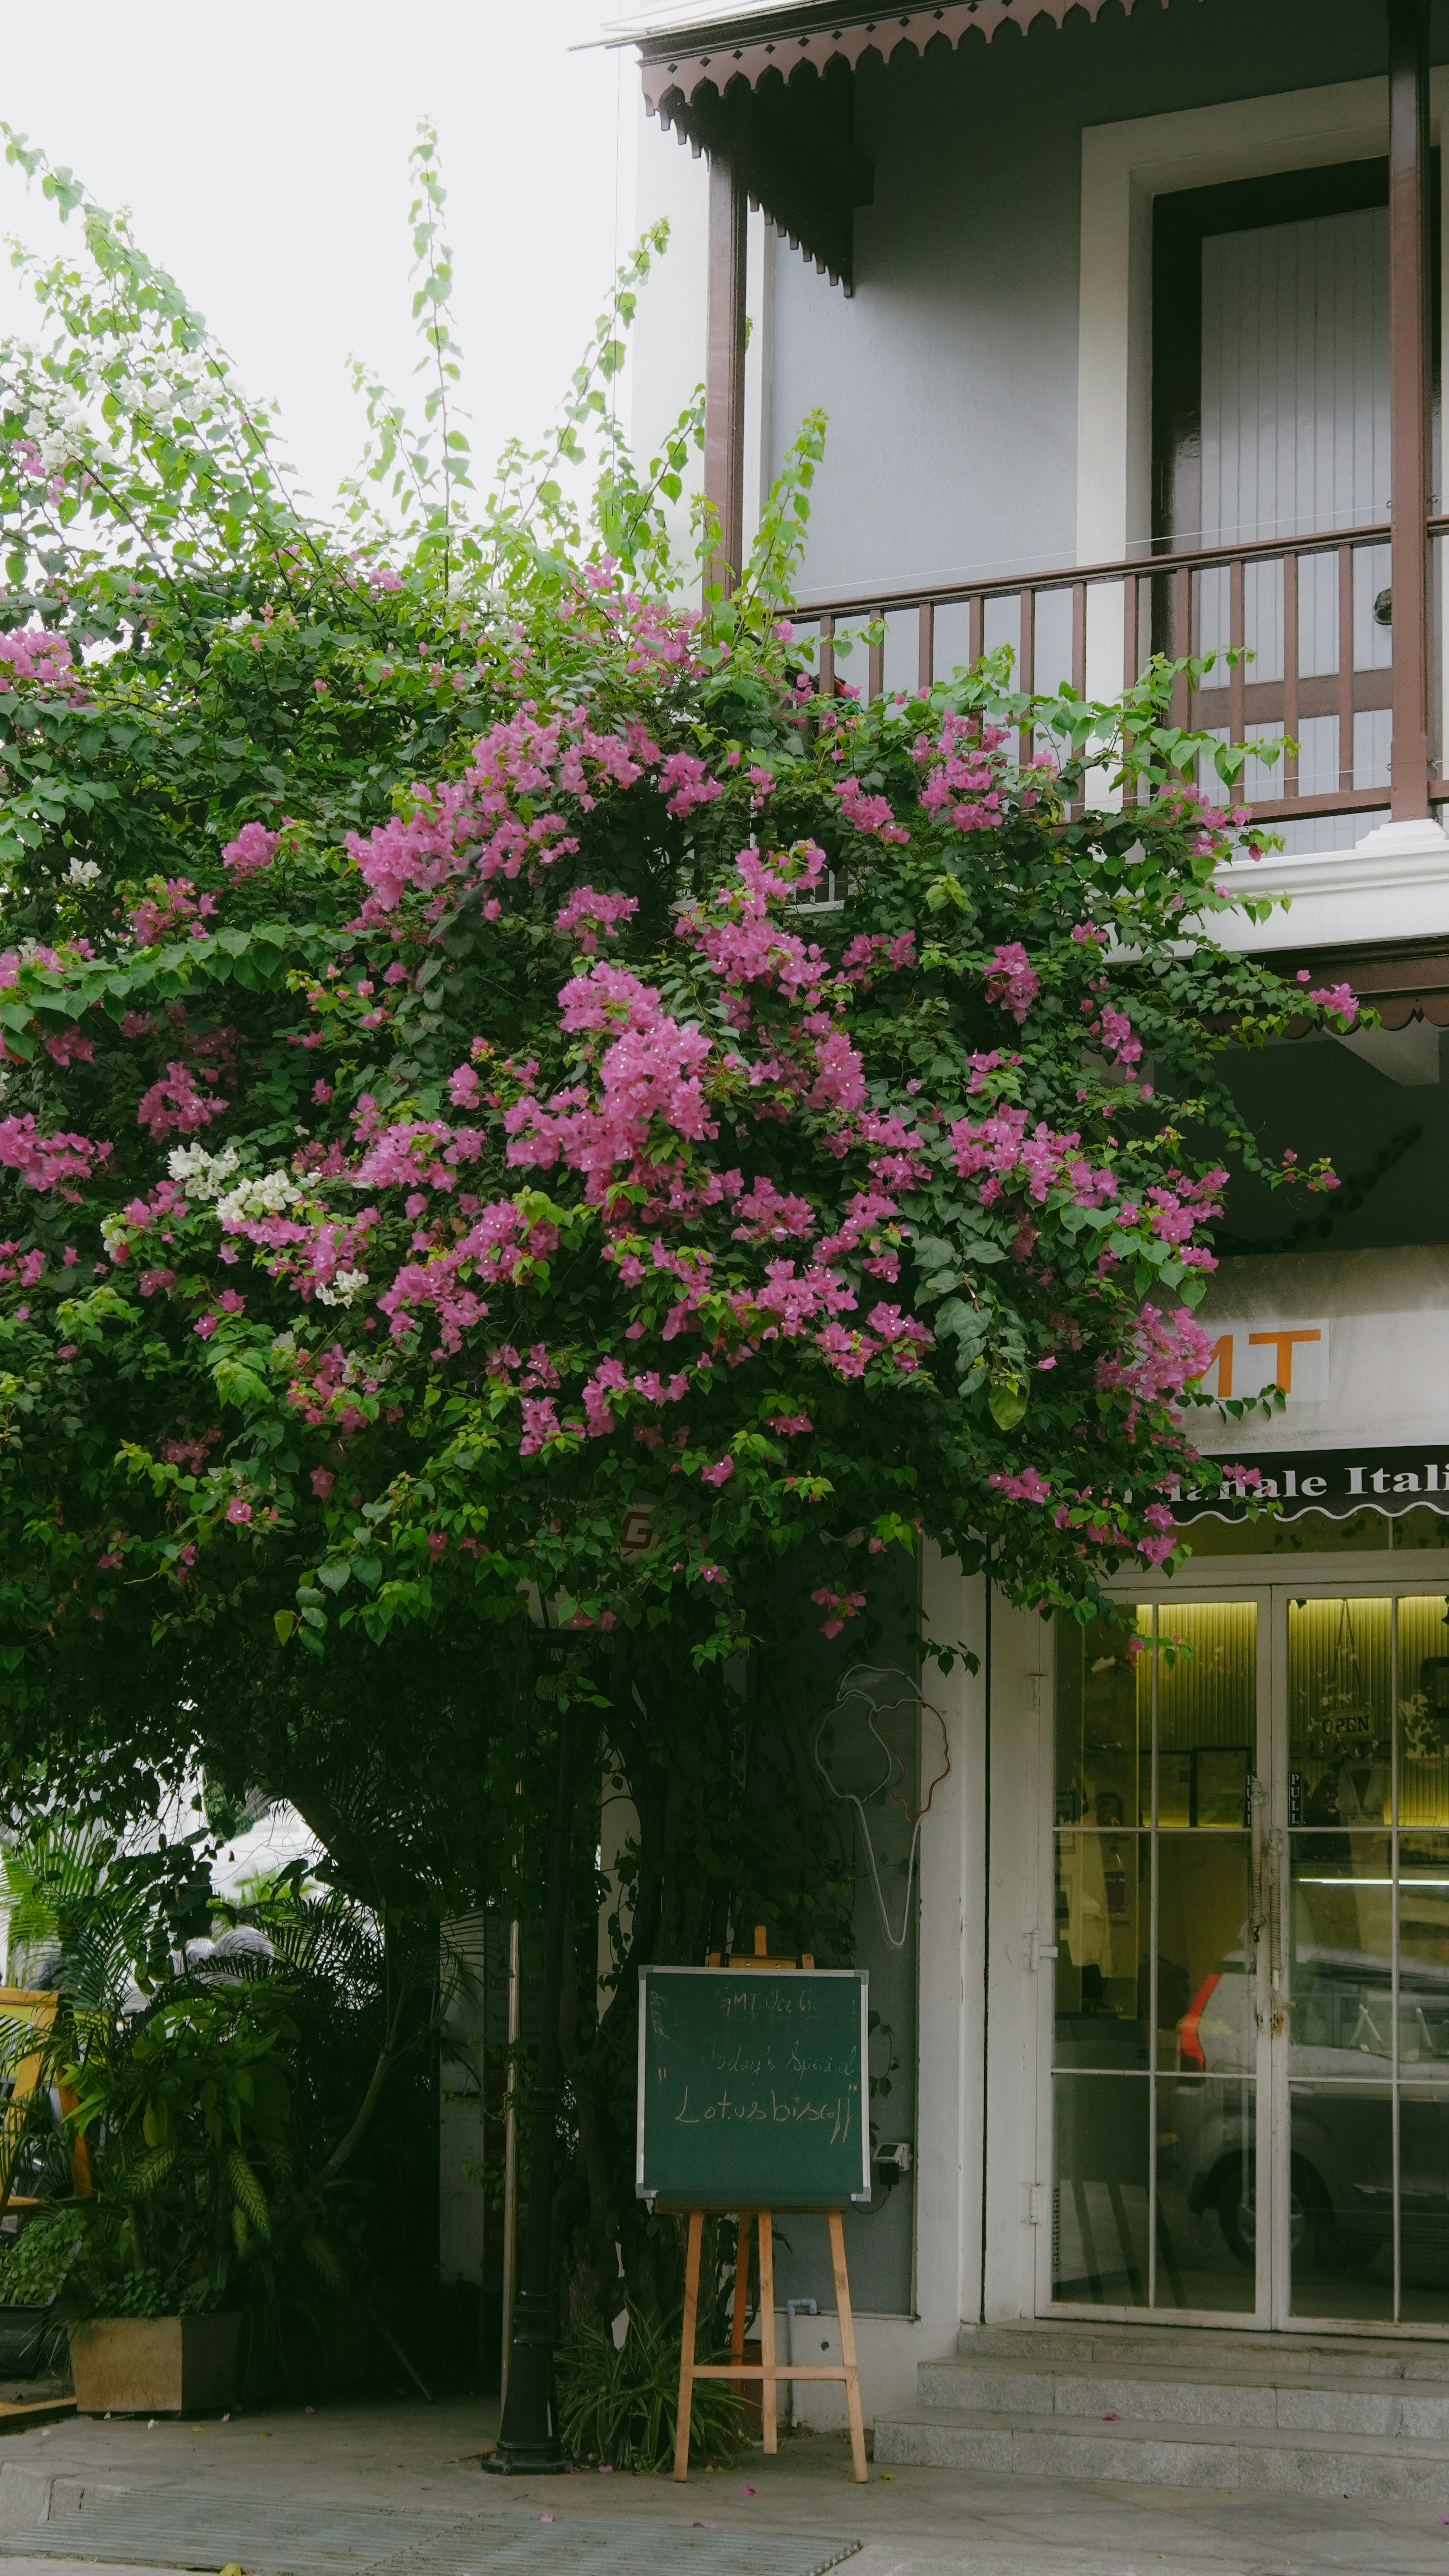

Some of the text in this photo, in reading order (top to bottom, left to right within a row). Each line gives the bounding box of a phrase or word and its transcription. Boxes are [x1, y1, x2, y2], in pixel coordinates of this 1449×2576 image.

[551, 1648, 564, 1661] PONDY
[1322, 1716, 1370, 1736] OPEN
[1291, 1774, 1300, 1824] PULL
